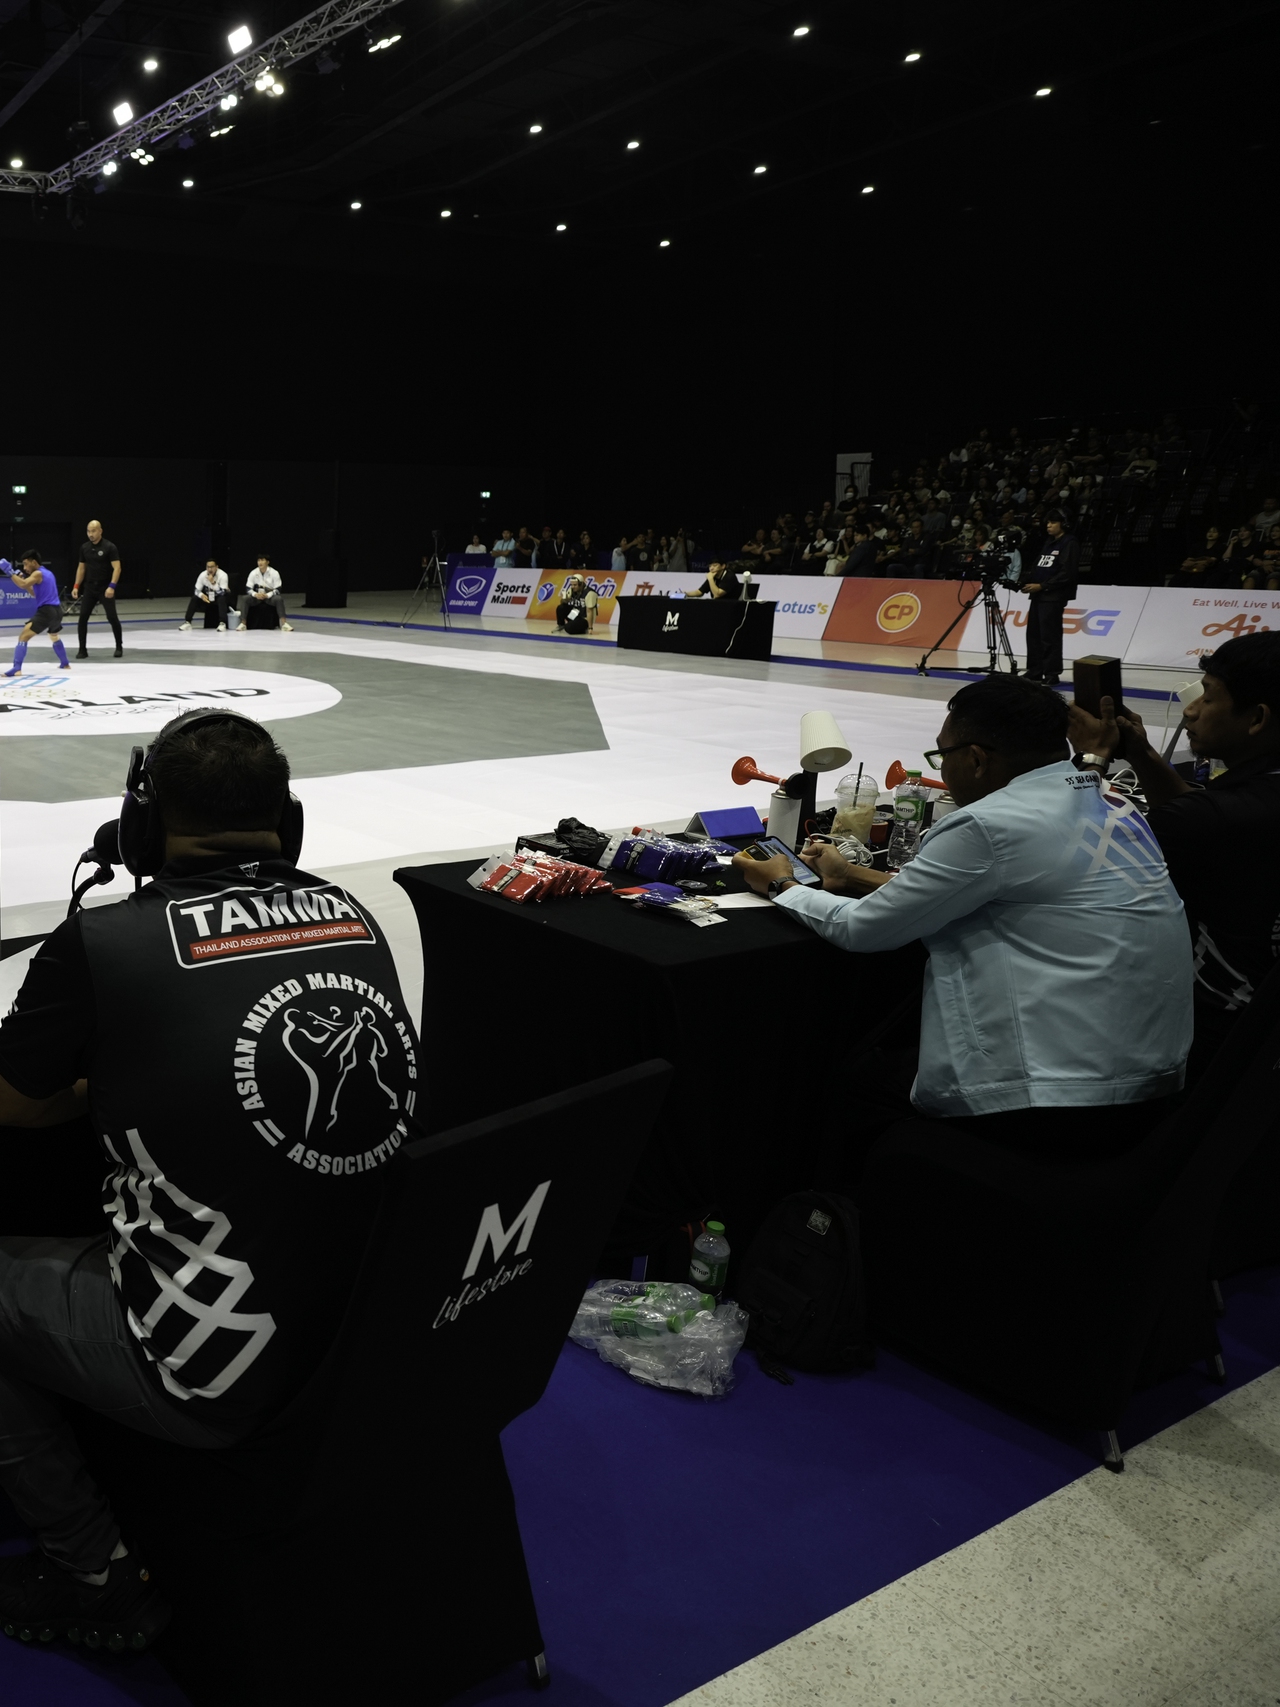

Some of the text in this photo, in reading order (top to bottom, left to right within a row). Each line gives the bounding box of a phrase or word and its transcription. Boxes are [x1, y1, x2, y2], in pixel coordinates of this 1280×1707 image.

[491, 595, 512, 605] Mall
[495, 582, 532, 595] Sports
[774, 600, 829, 615] Lotus's
[883, 604, 914, 621] CP
[1192, 599, 1211, 607] Eat
[1213, 600, 1240, 609] Well,
[1243, 600, 1268, 609] Live
[665, 611, 680, 626] M
[180, 890, 358, 937] TAMMA
[193, 925, 365, 955] THAILAND ASSOCIATION OF MIXED MARTIAL ARTS
[234, 972, 418, 1111] ASIAN MIXED MARTIAL ARTS
[286, 1118, 409, 1176] ASSOCIATION
[462, 1179, 552, 1281] M
[432, 1258, 533, 1330] Lifestore
